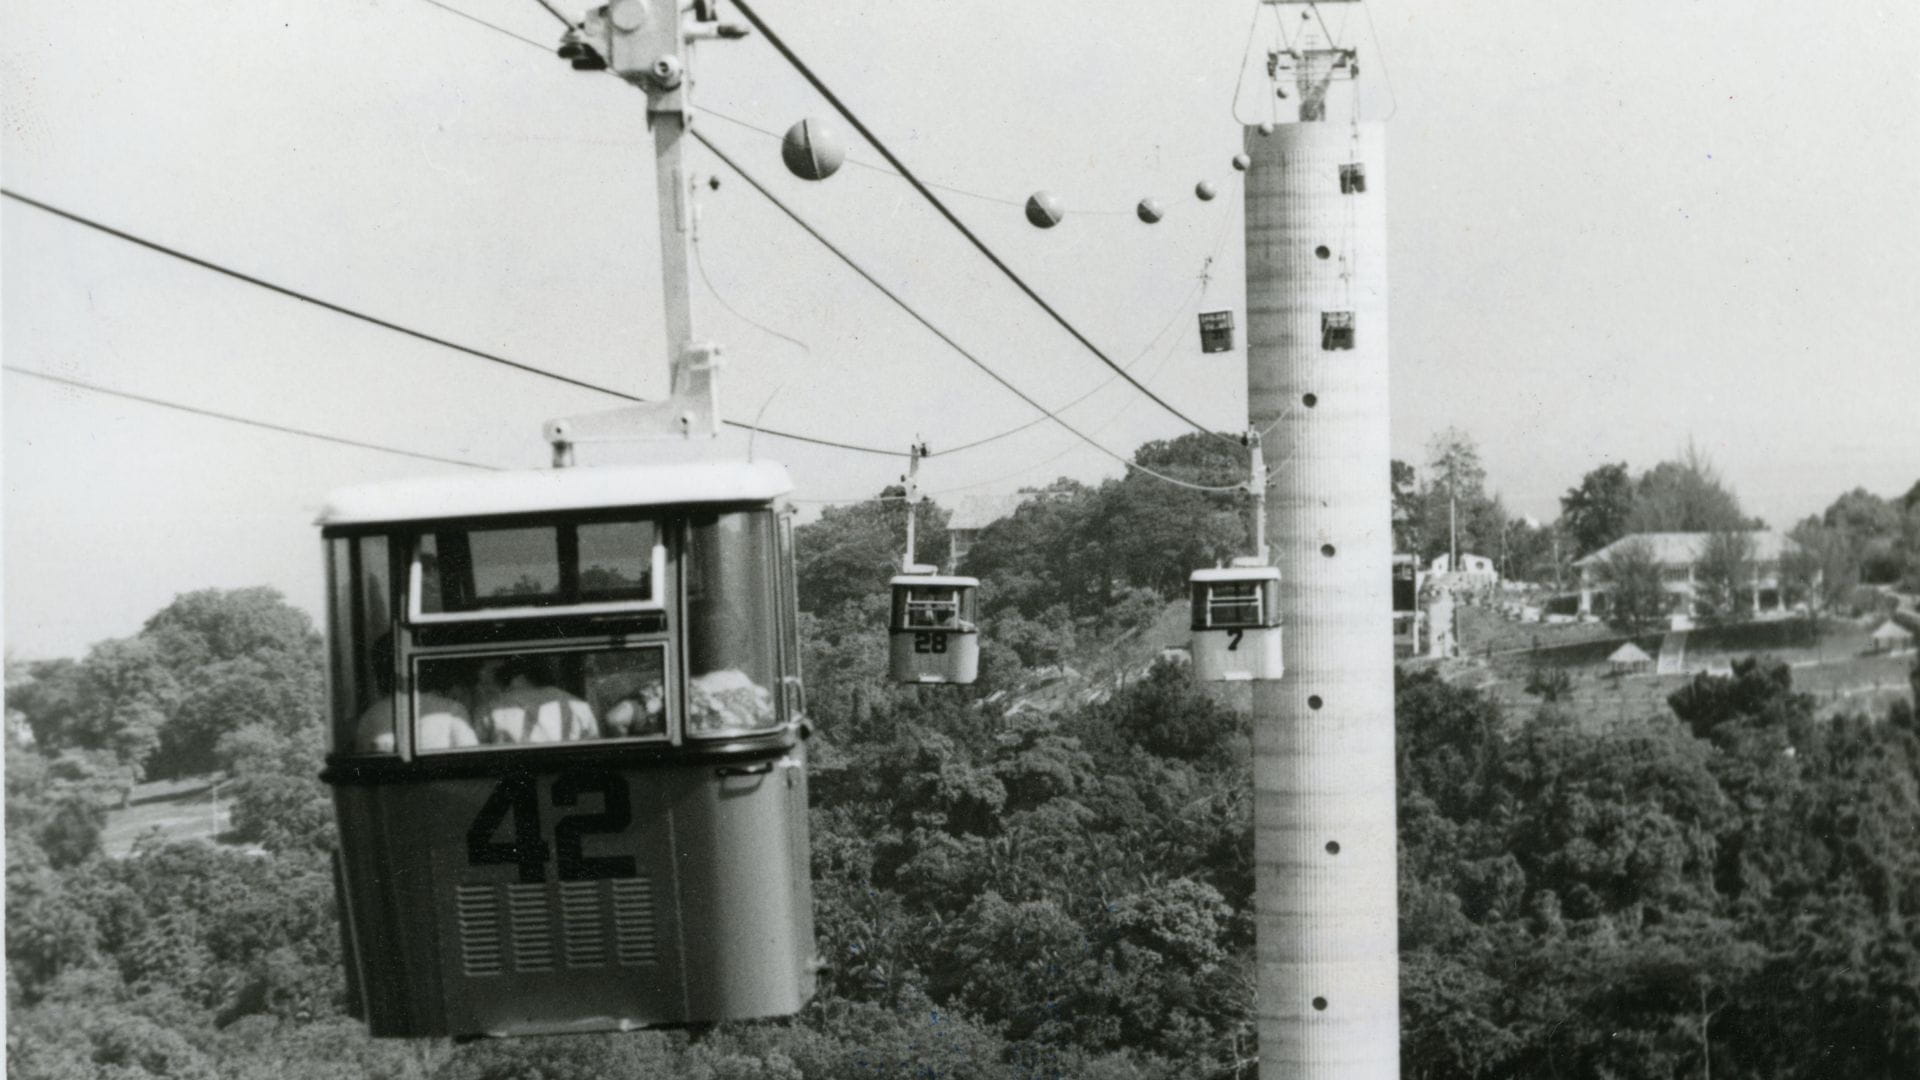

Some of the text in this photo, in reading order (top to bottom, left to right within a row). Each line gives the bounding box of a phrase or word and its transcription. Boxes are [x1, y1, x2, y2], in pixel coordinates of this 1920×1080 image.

[914, 630, 948, 654] 28
[1226, 628, 1244, 651] 7
[466, 770, 637, 883] 42
